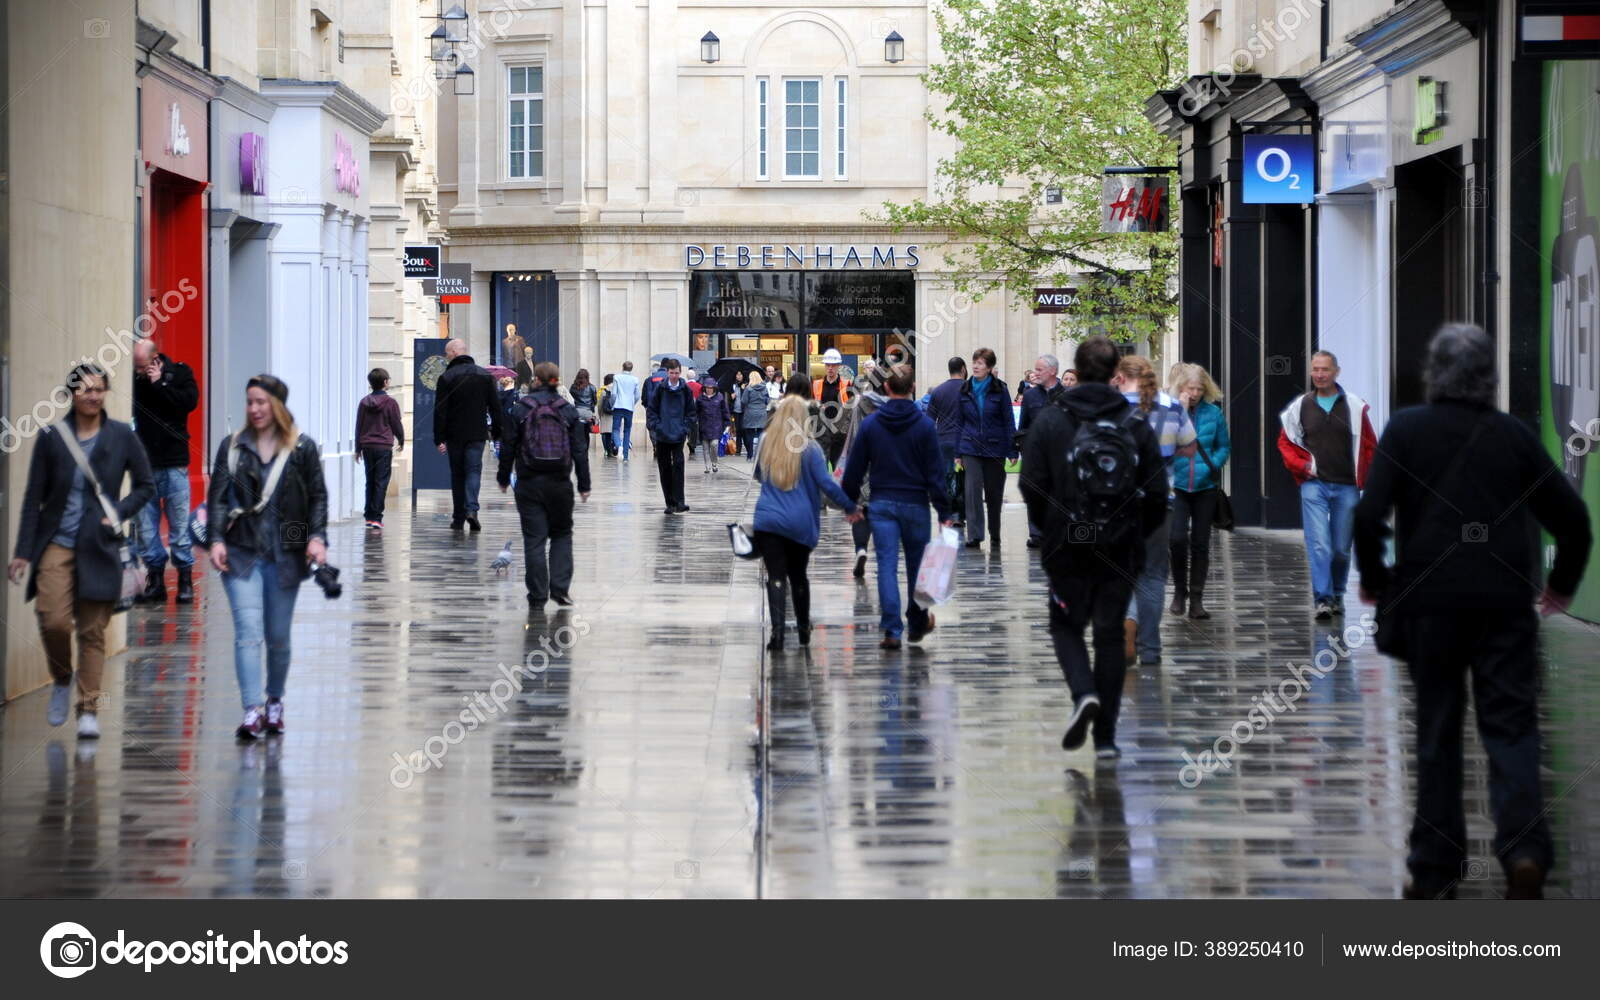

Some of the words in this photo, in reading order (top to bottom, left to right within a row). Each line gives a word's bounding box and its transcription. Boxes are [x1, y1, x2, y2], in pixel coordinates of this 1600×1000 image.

[1109, 187, 1163, 222] H&M
[685, 244, 921, 268] DEBENHAMS
[436, 278, 463, 286] RIVER
[436, 286, 470, 294] ISLAND
[707, 281, 741, 298] Life
[871, 285, 881, 293] of
[885, 296, 905, 305] and
[1037, 294, 1080, 305] AVEDA
[706, 300, 778, 318] fabulous
[834, 307, 855, 317] style
[857, 307, 884, 316] ideas
